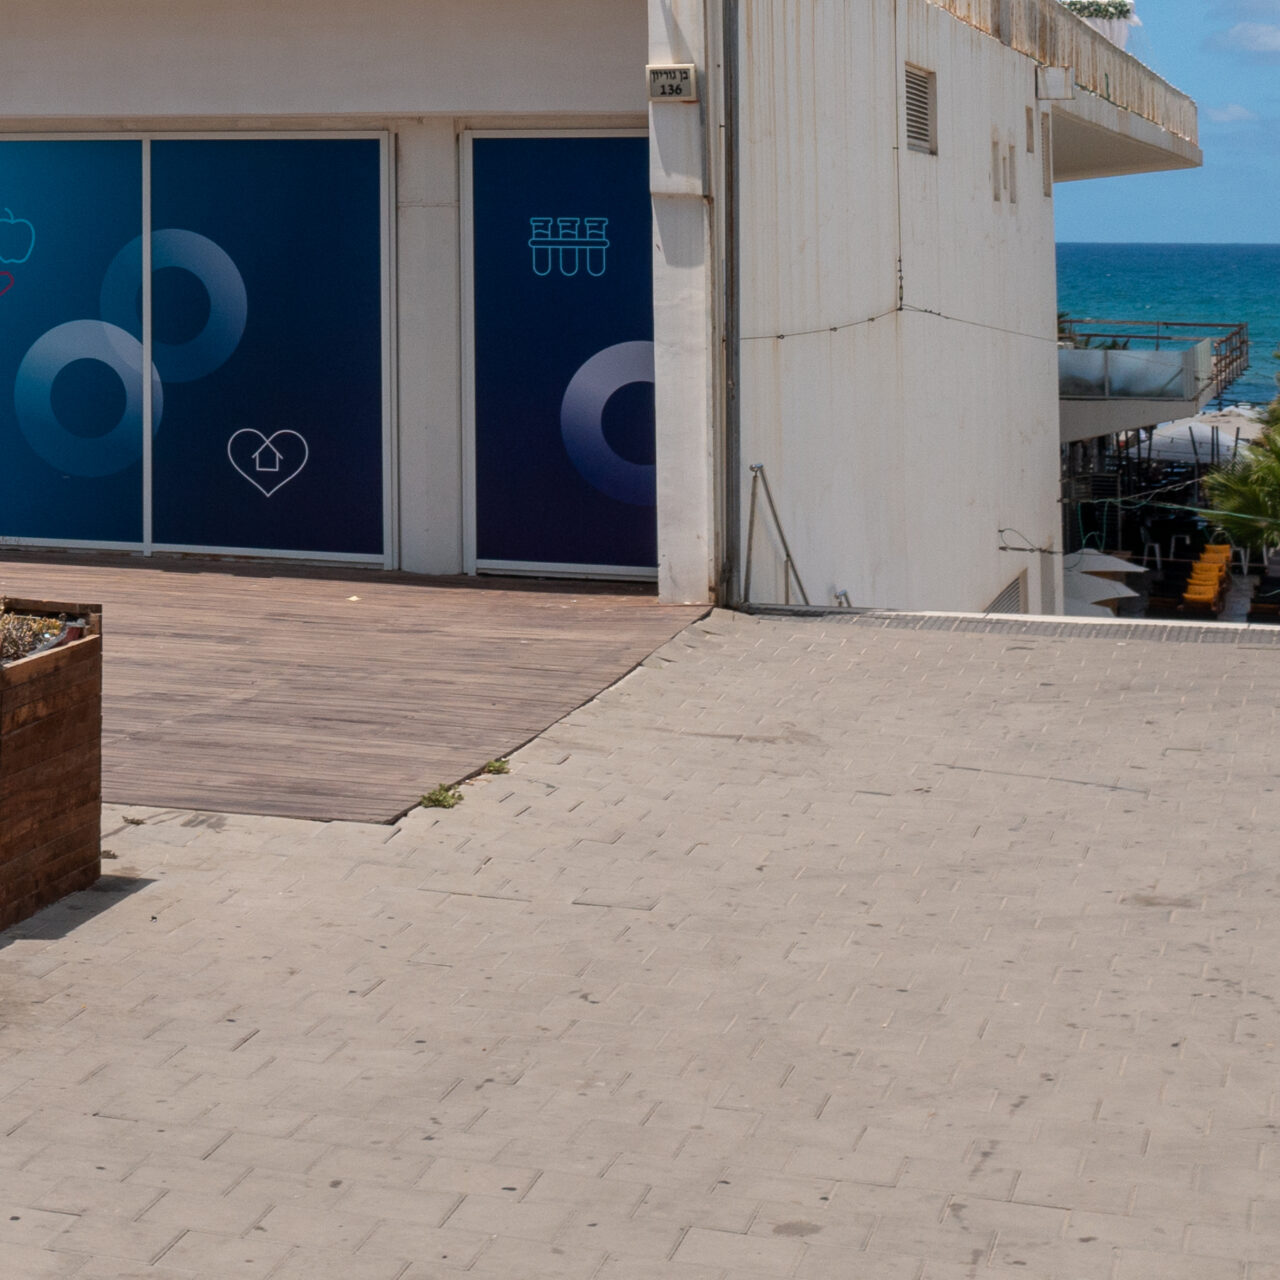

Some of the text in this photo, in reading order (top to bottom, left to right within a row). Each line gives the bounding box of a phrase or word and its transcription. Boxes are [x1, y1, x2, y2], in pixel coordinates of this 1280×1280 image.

[652, 71, 688, 83] בן גוריון
[660, 84, 682, 95] 136
